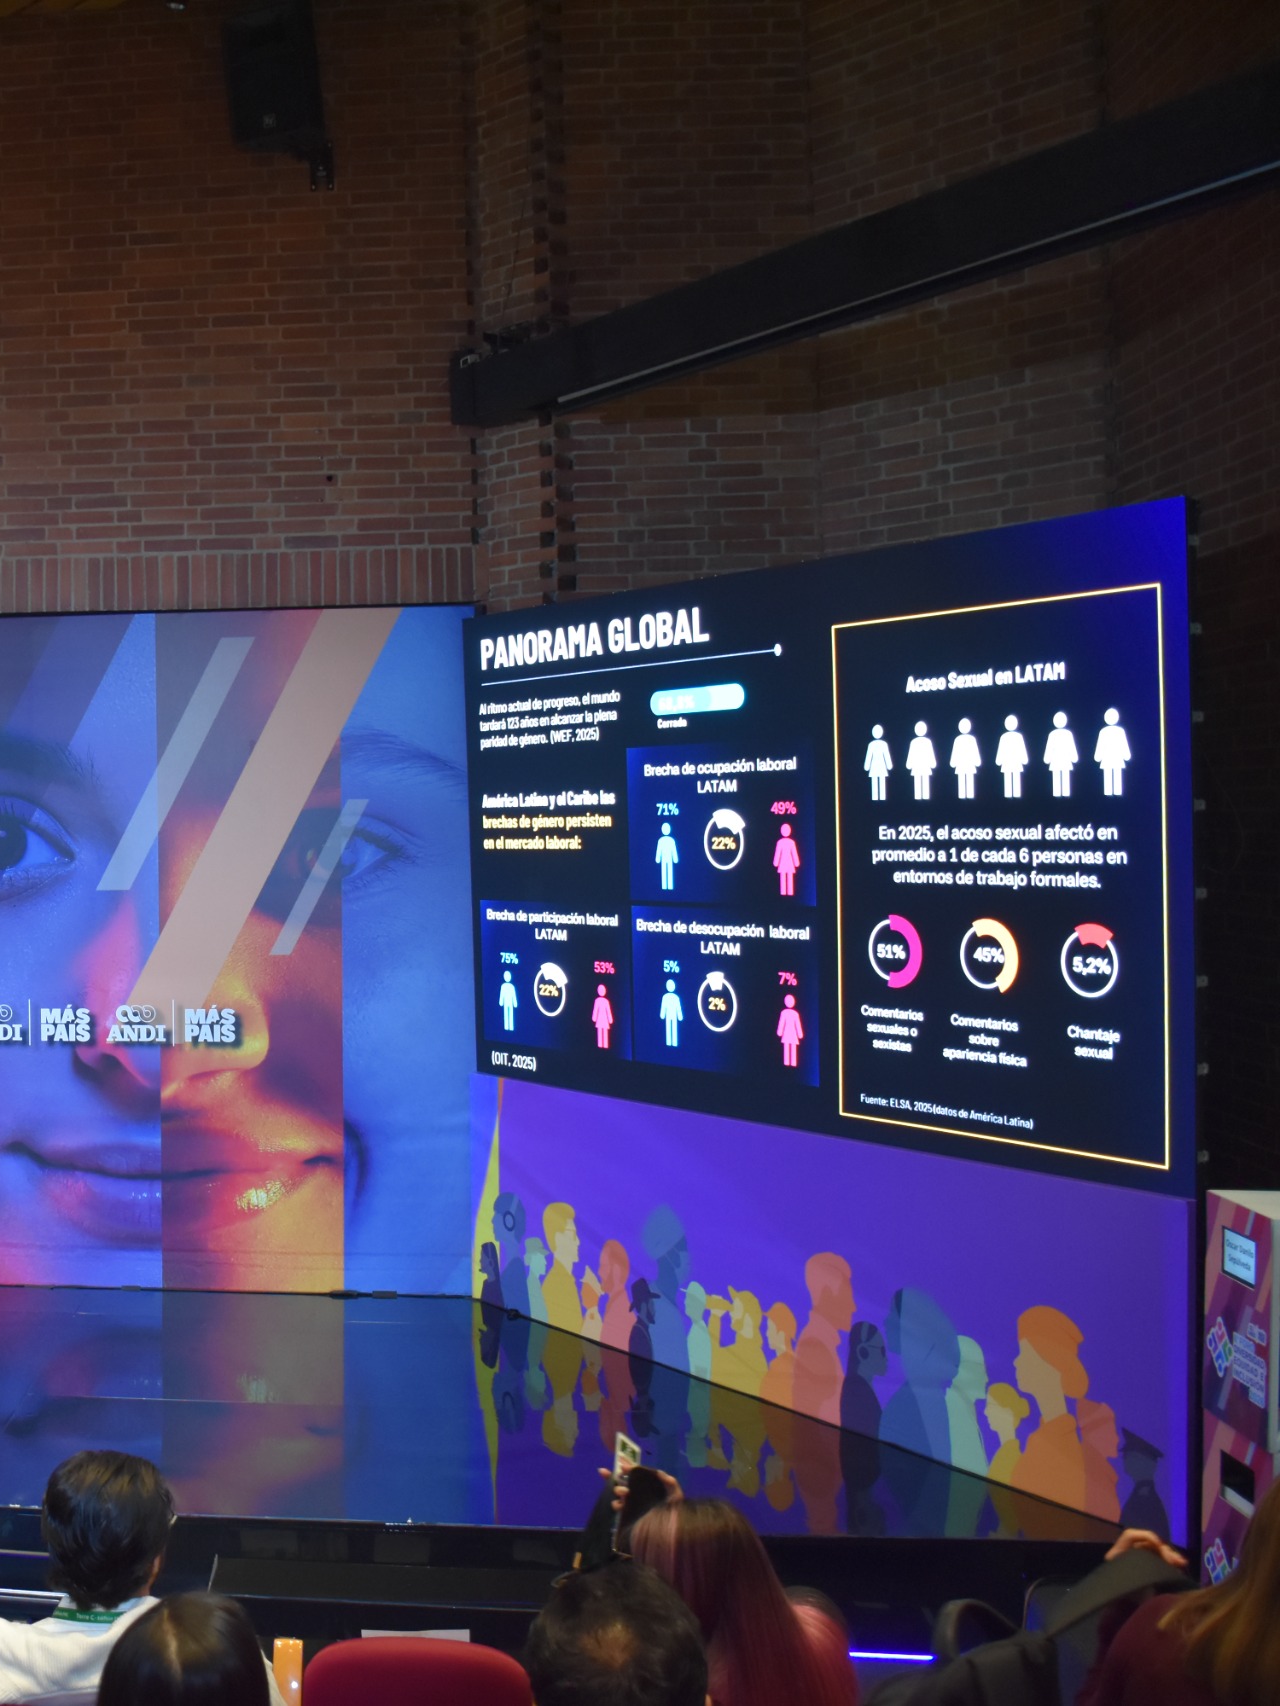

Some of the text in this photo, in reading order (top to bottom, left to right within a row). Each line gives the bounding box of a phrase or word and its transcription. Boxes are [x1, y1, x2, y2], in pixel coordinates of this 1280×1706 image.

[480, 607, 710, 670] PANORAMA GLOBAL
[906, 661, 1066, 693] Acoso Sexual en LATAM
[479, 689, 620, 715] Al ritmo actual de progreso, el mundo
[480, 709, 617, 731] tardará 123 años en alcanzar la plena
[480, 726, 600, 750] paridad de género. (WEF, 2025)
[644, 756, 797, 778] Brecha de ocupación laboral
[697, 779, 738, 794] LATAM
[482, 789, 616, 810] América Latina y el Caribe las
[771, 801, 797, 815] 49%
[656, 803, 679, 816] 71%
[483, 812, 612, 832] brechas de género persisten
[879, 823, 1118, 842] En 2025, el acoso sexual afectó en
[483, 835, 582, 849] en el mercado laboral:
[712, 837, 736, 850] 22%
[872, 847, 1128, 866] promedio a 1 de cada 6 personas en
[893, 870, 1101, 890] entornos de trabajo formales.
[486, 908, 618, 927] Brecha de participación laboral
[535, 928, 567, 941] LATAM
[636, 919, 810, 941] Brecha de desocupación laboral
[700, 941, 741, 956] LATAM
[876, 943, 906, 959] 51%
[973, 946, 1005, 963] 45%
[500, 952, 519, 965] 75%
[663, 960, 680, 974] 5%
[1072, 956, 1111, 975] 5,2%
[594, 961, 615, 975] 53%
[778, 972, 798, 986] 7%
[539, 983, 559, 997] 22%
[708, 997, 726, 1011] 2%
[861, 1004, 924, 1021] Comentarios
[40, 1004, 91, 1024] MÁS
[184, 1005, 236, 1025] MÁS
[950, 1014, 1019, 1032] Comentarios
[106, 1025, 166, 1043] ANDI
[867, 1023, 918, 1037] sexuales o
[1067, 1026, 1120, 1044] Chantaje
[873, 1039, 912, 1052] sexistas
[968, 1033, 1000, 1047] sobre
[491, 1051, 537, 1071] (OIT, 2025)
[943, 1047, 1027, 1067] apariencia física
[1075, 1044, 1113, 1061] sexual
[860, 1093, 889, 1107] Fuente:
[890, 1098, 912, 1111] ELSA,
[958, 1108, 969, 1119] de
[970, 1109, 1003, 1125] América
[1004, 1115, 1034, 1130] Latina)
